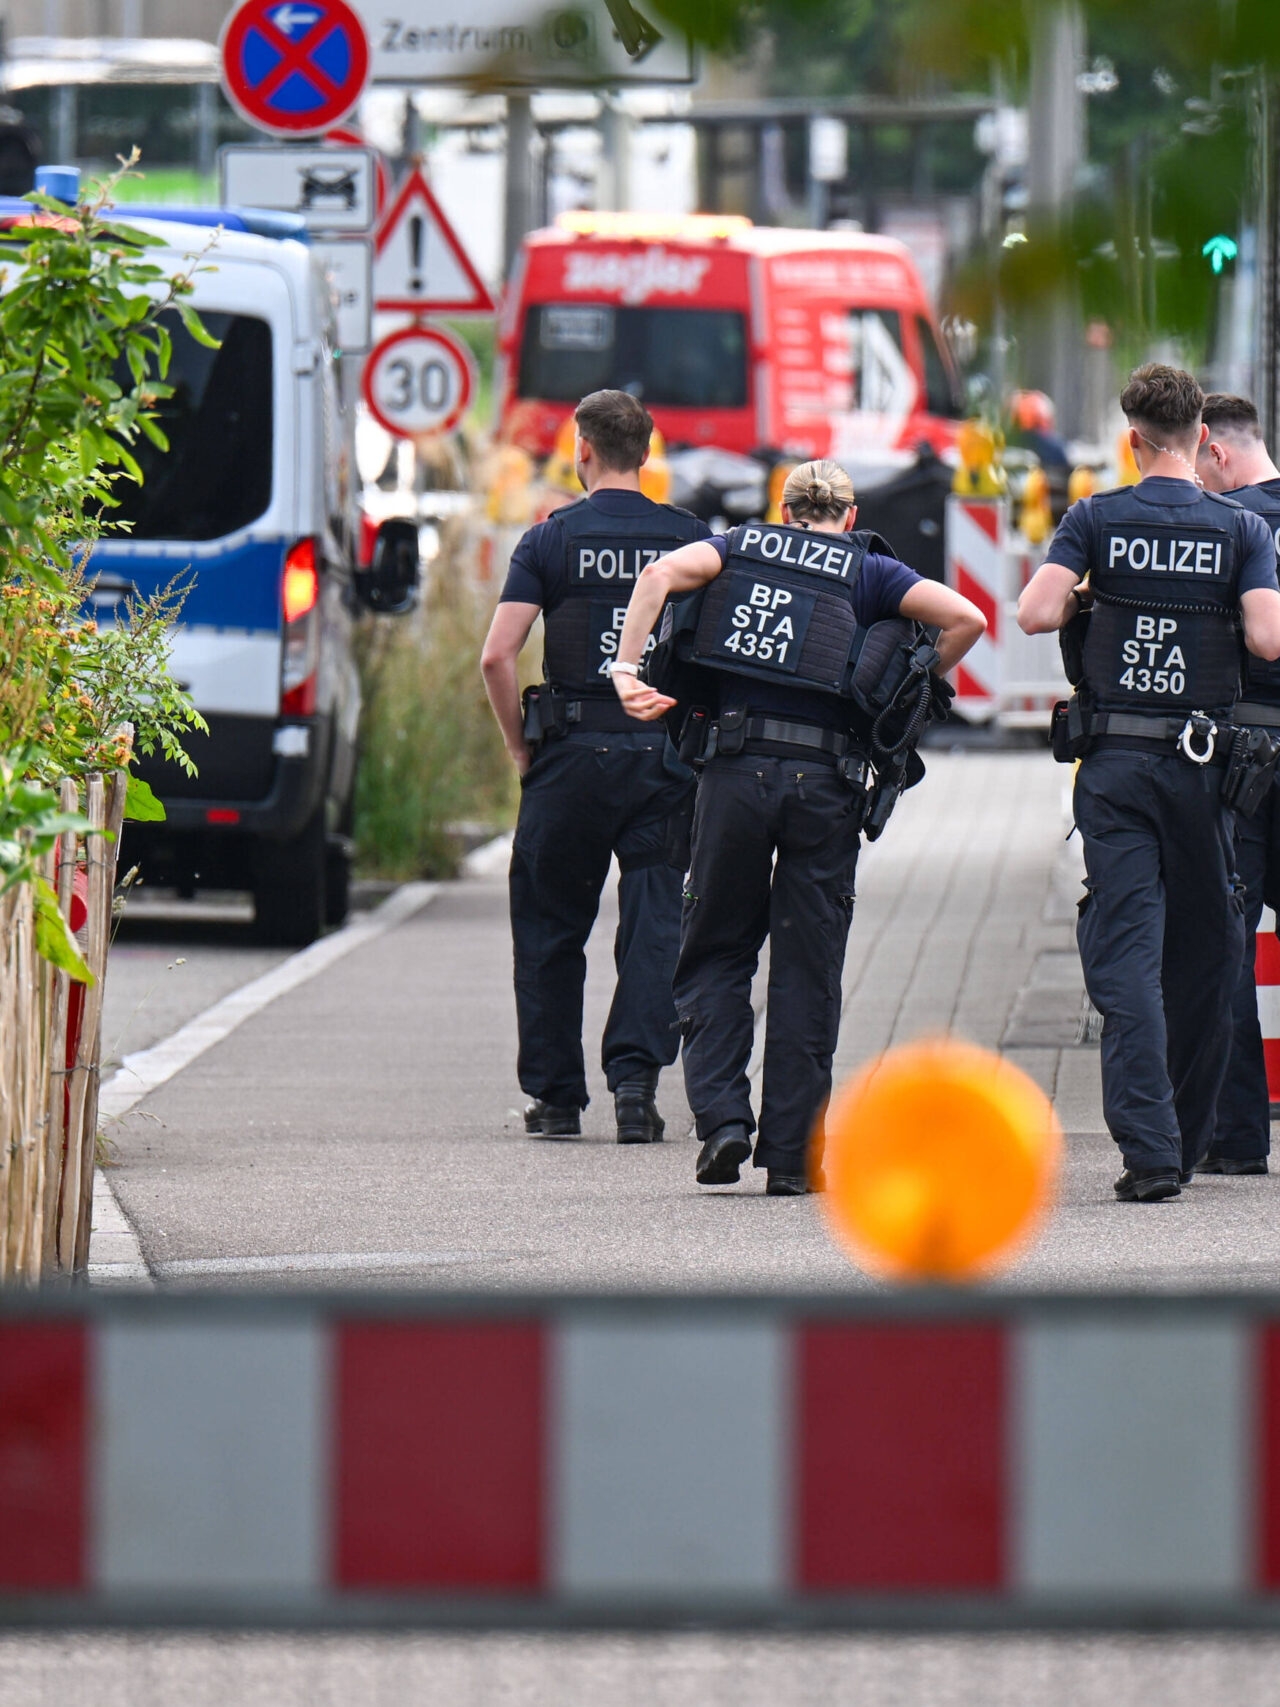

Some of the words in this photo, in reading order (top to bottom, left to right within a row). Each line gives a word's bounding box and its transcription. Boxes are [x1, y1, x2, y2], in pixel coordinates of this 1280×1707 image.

[386, 360, 448, 413] 30
[740, 528, 853, 578] POLIZEI
[1109, 536, 1222, 575] POLIZEI
[750, 583, 793, 610] BP
[731, 604, 794, 640] STA
[1136, 615, 1178, 641] BP
[600, 631, 657, 656] SA
[724, 630, 789, 664] 4351
[1122, 640, 1186, 670] STA
[1119, 666, 1186, 695] 4350
